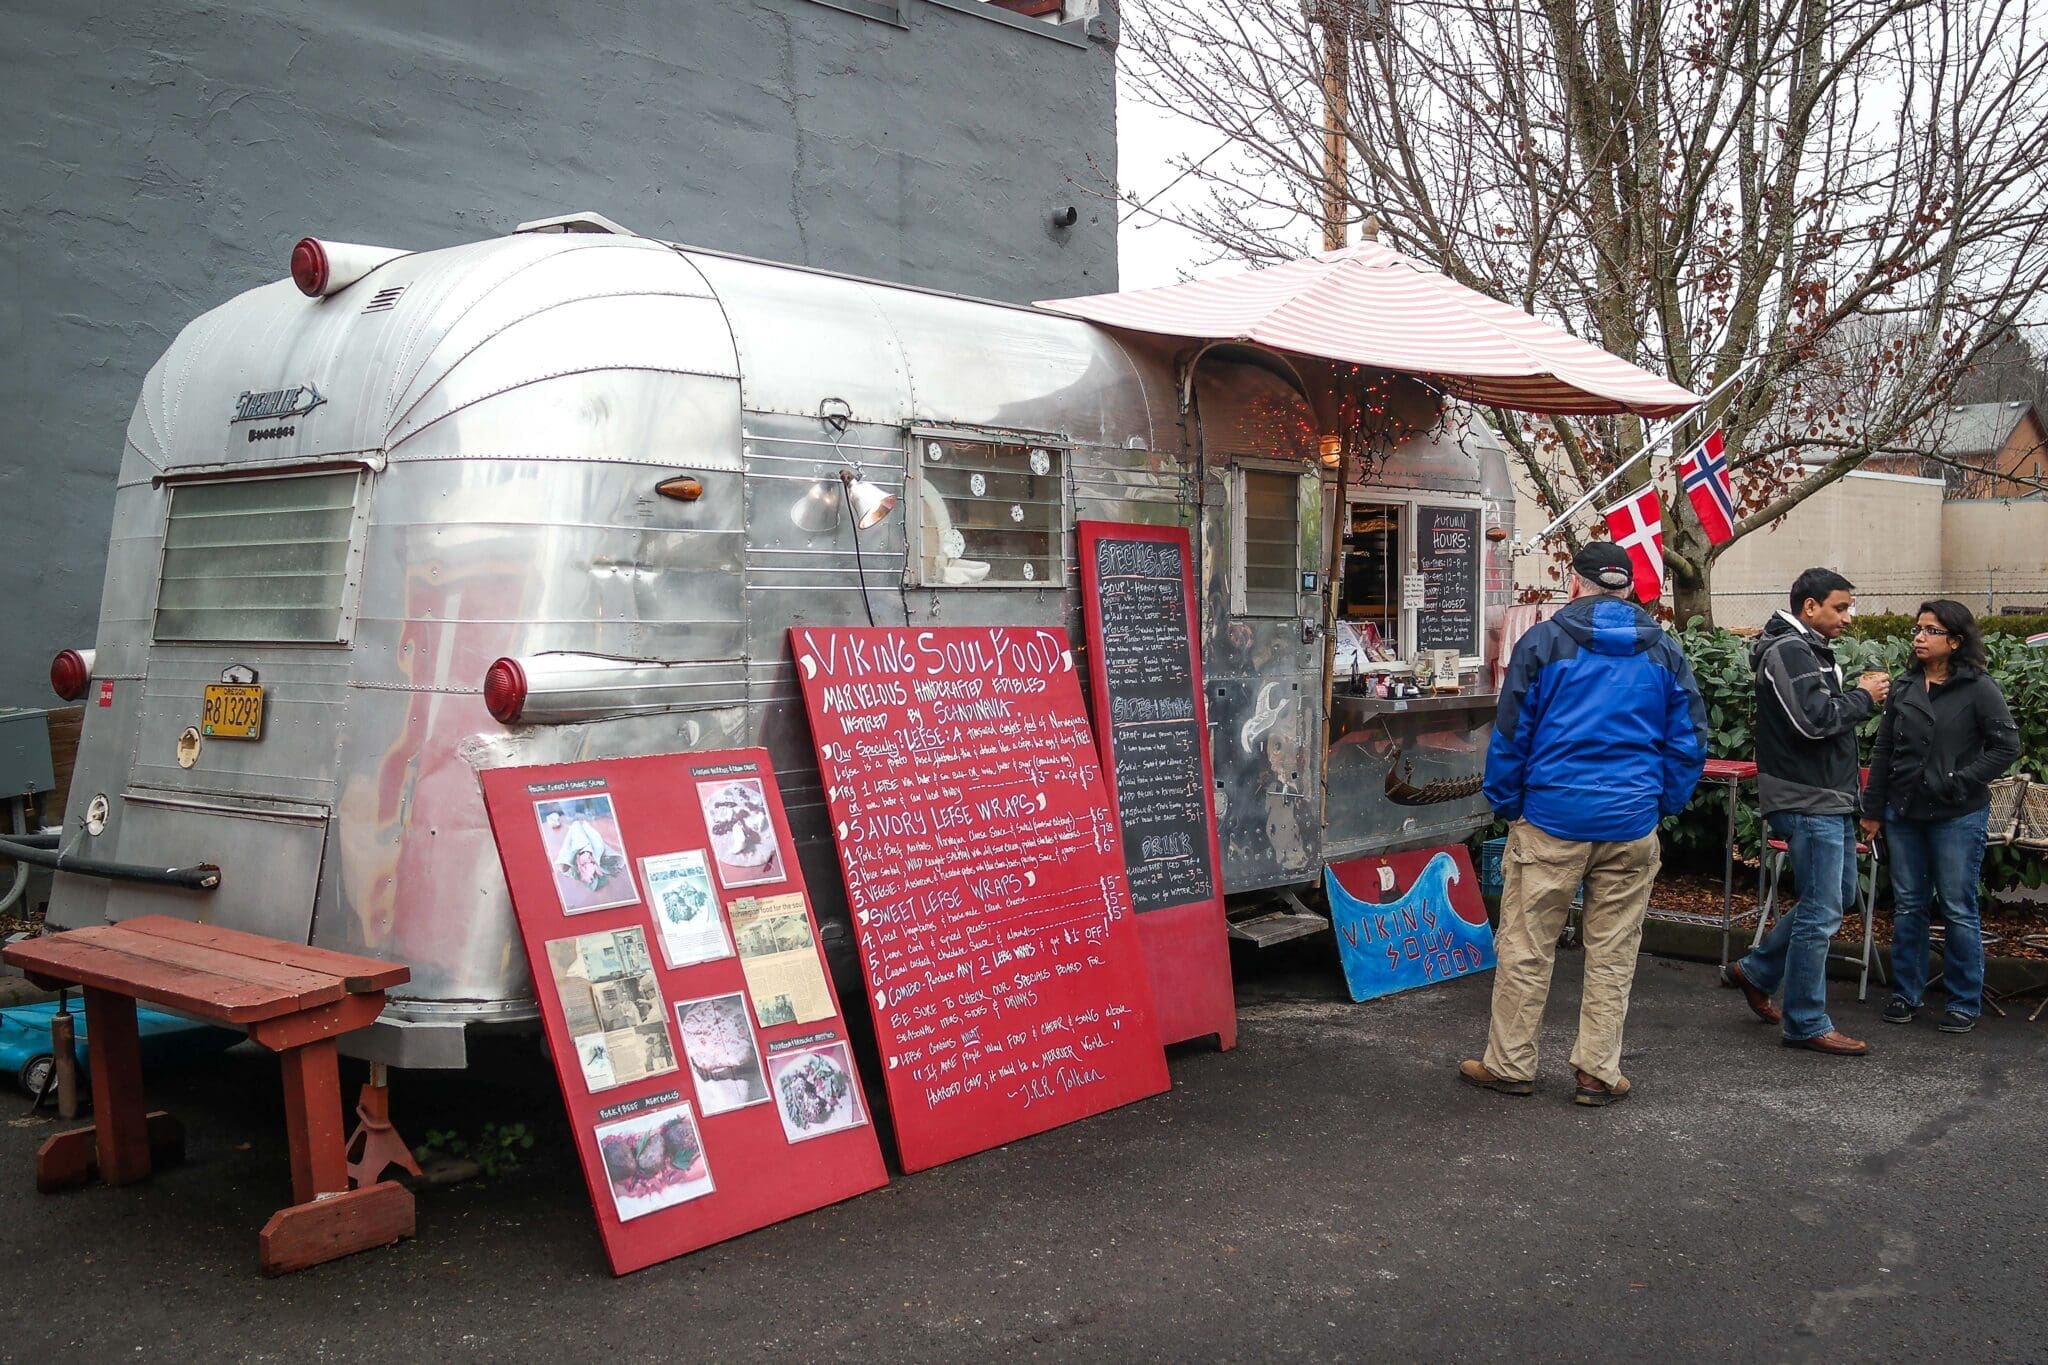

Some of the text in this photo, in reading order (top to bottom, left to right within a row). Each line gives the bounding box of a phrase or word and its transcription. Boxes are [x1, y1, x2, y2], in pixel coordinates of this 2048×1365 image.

[1434, 514, 1467, 529] AUTUMN
[1433, 533, 1471, 549] HOURS:
[1442, 599, 1466, 609] CLOSED
[804, 630, 916, 676] VIKING
[917, 632, 993, 675] SOUL
[224, 687, 247, 696] OREGON
[822, 677, 1046, 714] MARVELOUS HANDCRAFTED EDIBLES
[205, 695, 259, 726] R813293
[840, 712, 888, 735] INSPIRED
[1038, 715, 1047, 732] of
[862, 760, 872, 772] is
[875, 761, 883, 769] a
[862, 780, 872, 797] 1
[850, 793, 1036, 842] SAVORY LEFSE WRAPS
[855, 845, 877, 867] Pork
[848, 870, 863, 890] 2
[760, 906, 773, 914] food
[774, 903, 782, 911] for
[783, 902, 792, 910] the
[869, 873, 1022, 928] SWEET LEFSE WRAPS
[876, 929, 898, 945] Local
[1341, 898, 1436, 949] VIKING
[956, 959, 975, 984] ANY
[977, 955, 990, 972] 2
[1423, 941, 1483, 983] FOOD
[890, 1012, 912, 1029] BE
[912, 1002, 938, 1020] SURE
[958, 988, 993, 1005] CHECK
[992, 981, 1011, 996] OUR
[1013, 968, 1052, 990] SPECIALS
[1055, 961, 1083, 977] BOARD
[896, 1023, 936, 1044] SEASONAL
[964, 1004, 988, 1019] SIDES
[1003, 989, 1038, 1010] DRINKS
[1006, 1030, 1027, 1050] FOOD
[1040, 1015, 1070, 1036] CHEER
[1075, 1008, 1100, 1026] SONG
[989, 1069, 998, 1084] it
[1017, 1058, 1029, 1074] be
[1031, 1059, 1040, 1069] a
[1041, 1044, 1083, 1070] MERRIER
[1056, 1065, 1106, 1094] Tolkien
[600, 1090, 680, 1119] PORK BEEF MEATBALLS
